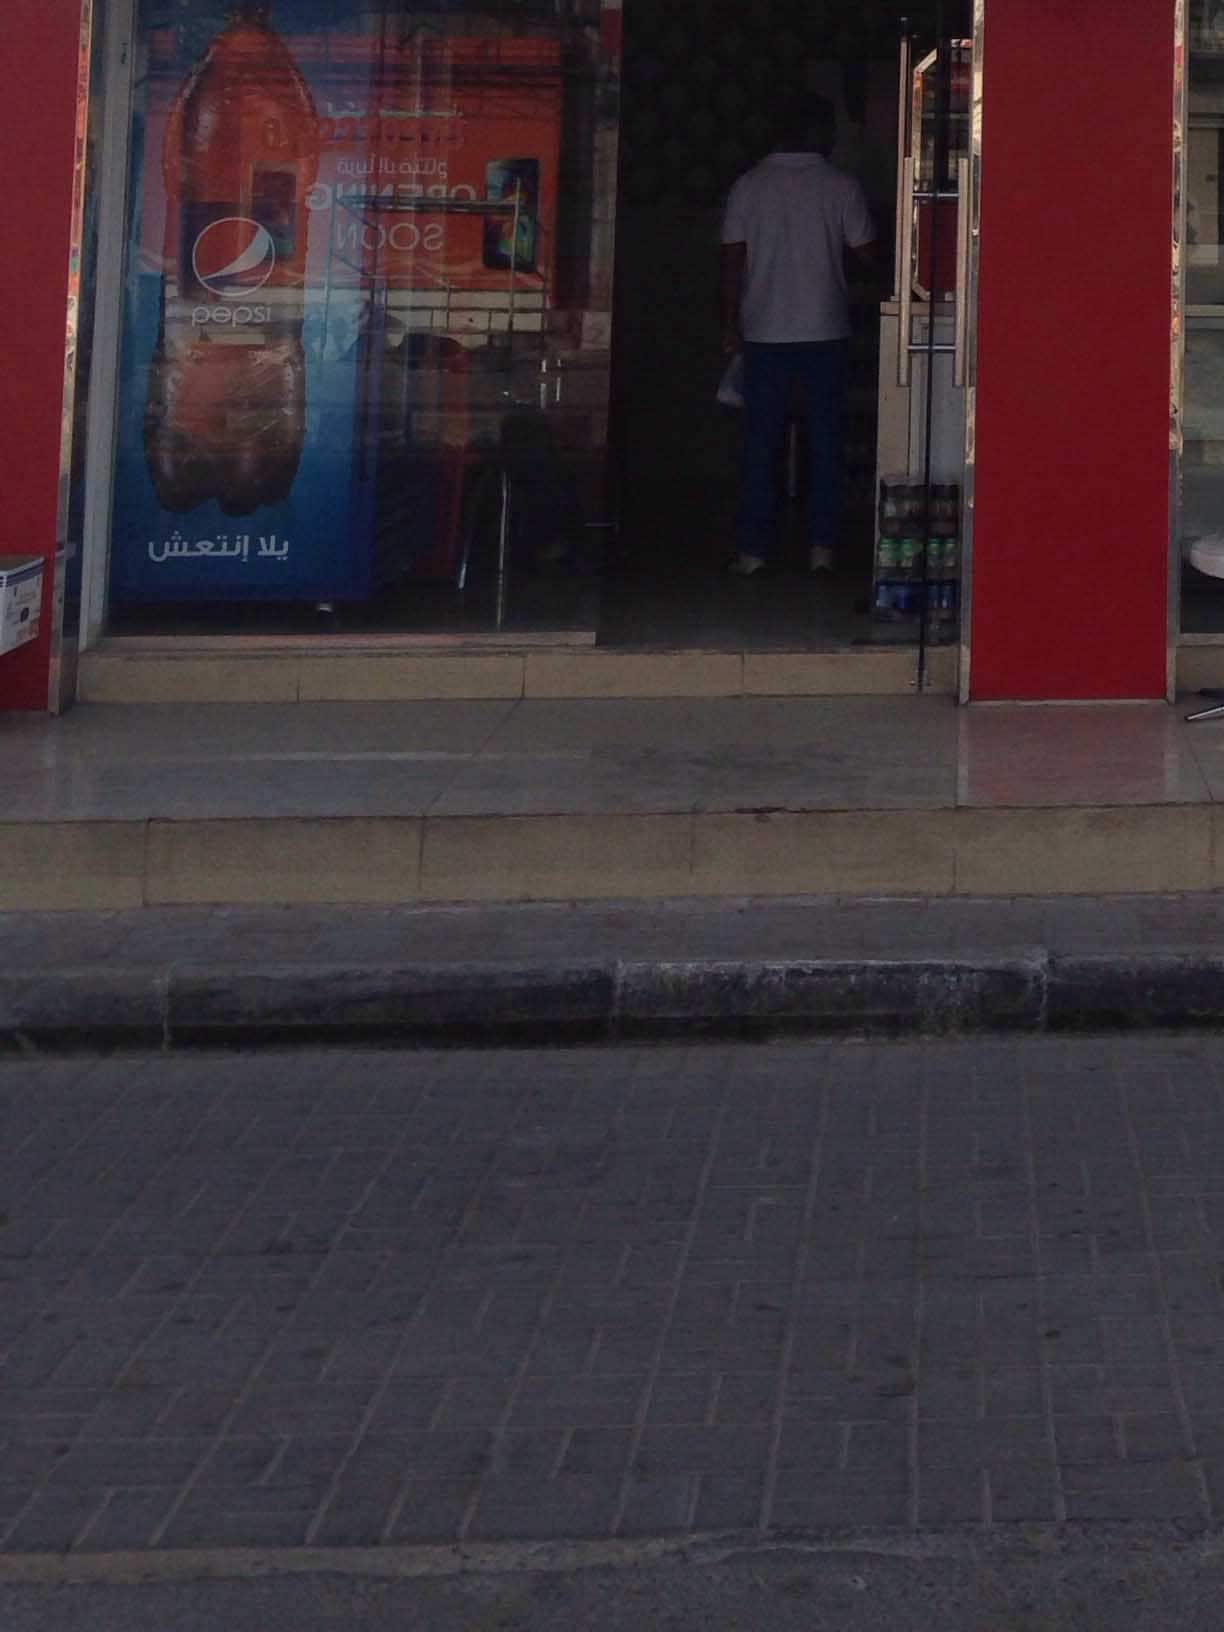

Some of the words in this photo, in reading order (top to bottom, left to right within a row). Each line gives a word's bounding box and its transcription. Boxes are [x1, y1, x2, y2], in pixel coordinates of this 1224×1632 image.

[191, 306, 271, 327] pepsi
[148, 532, 249, 562] إنتعش
[256, 535, 289, 561] يلا
